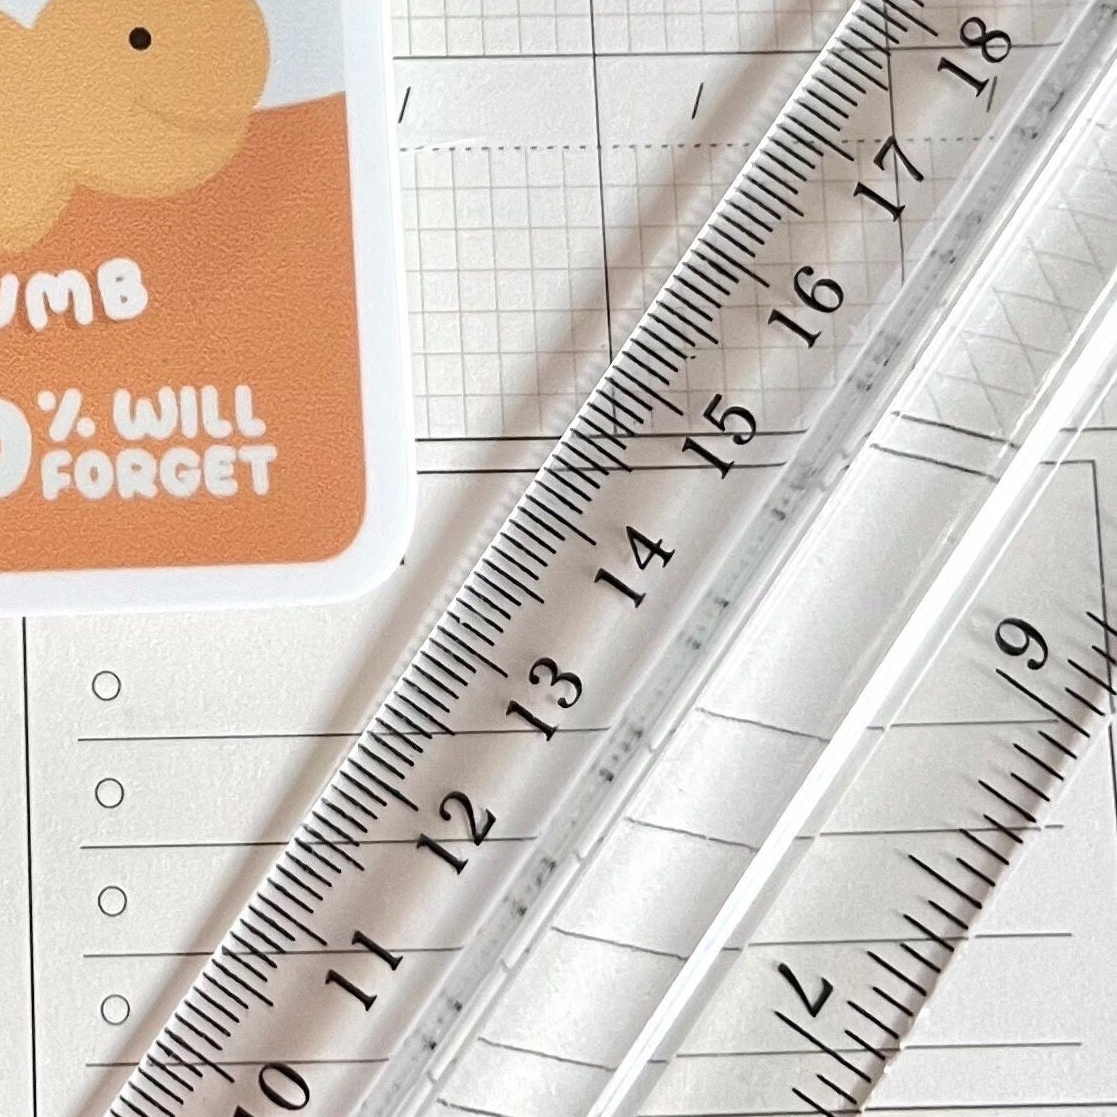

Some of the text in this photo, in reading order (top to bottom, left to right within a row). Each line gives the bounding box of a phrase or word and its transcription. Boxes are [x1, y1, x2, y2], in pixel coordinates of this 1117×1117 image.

[937, 16, 1012, 97] 18
[853, 136, 925, 222] 17
[768, 265, 845, 348] 16
[111, 384, 267, 442] WILL
[681, 393, 758, 479] 15
[40, 444, 278, 501] FORGET
[594, 524, 677, 609] 14
[505, 657, 584, 742] 13
[416, 789, 497, 875] 12
[325, 930, 403, 1011] 11
[777, 962, 834, 1018] 7
[233, 1063, 310, 1117] 0
